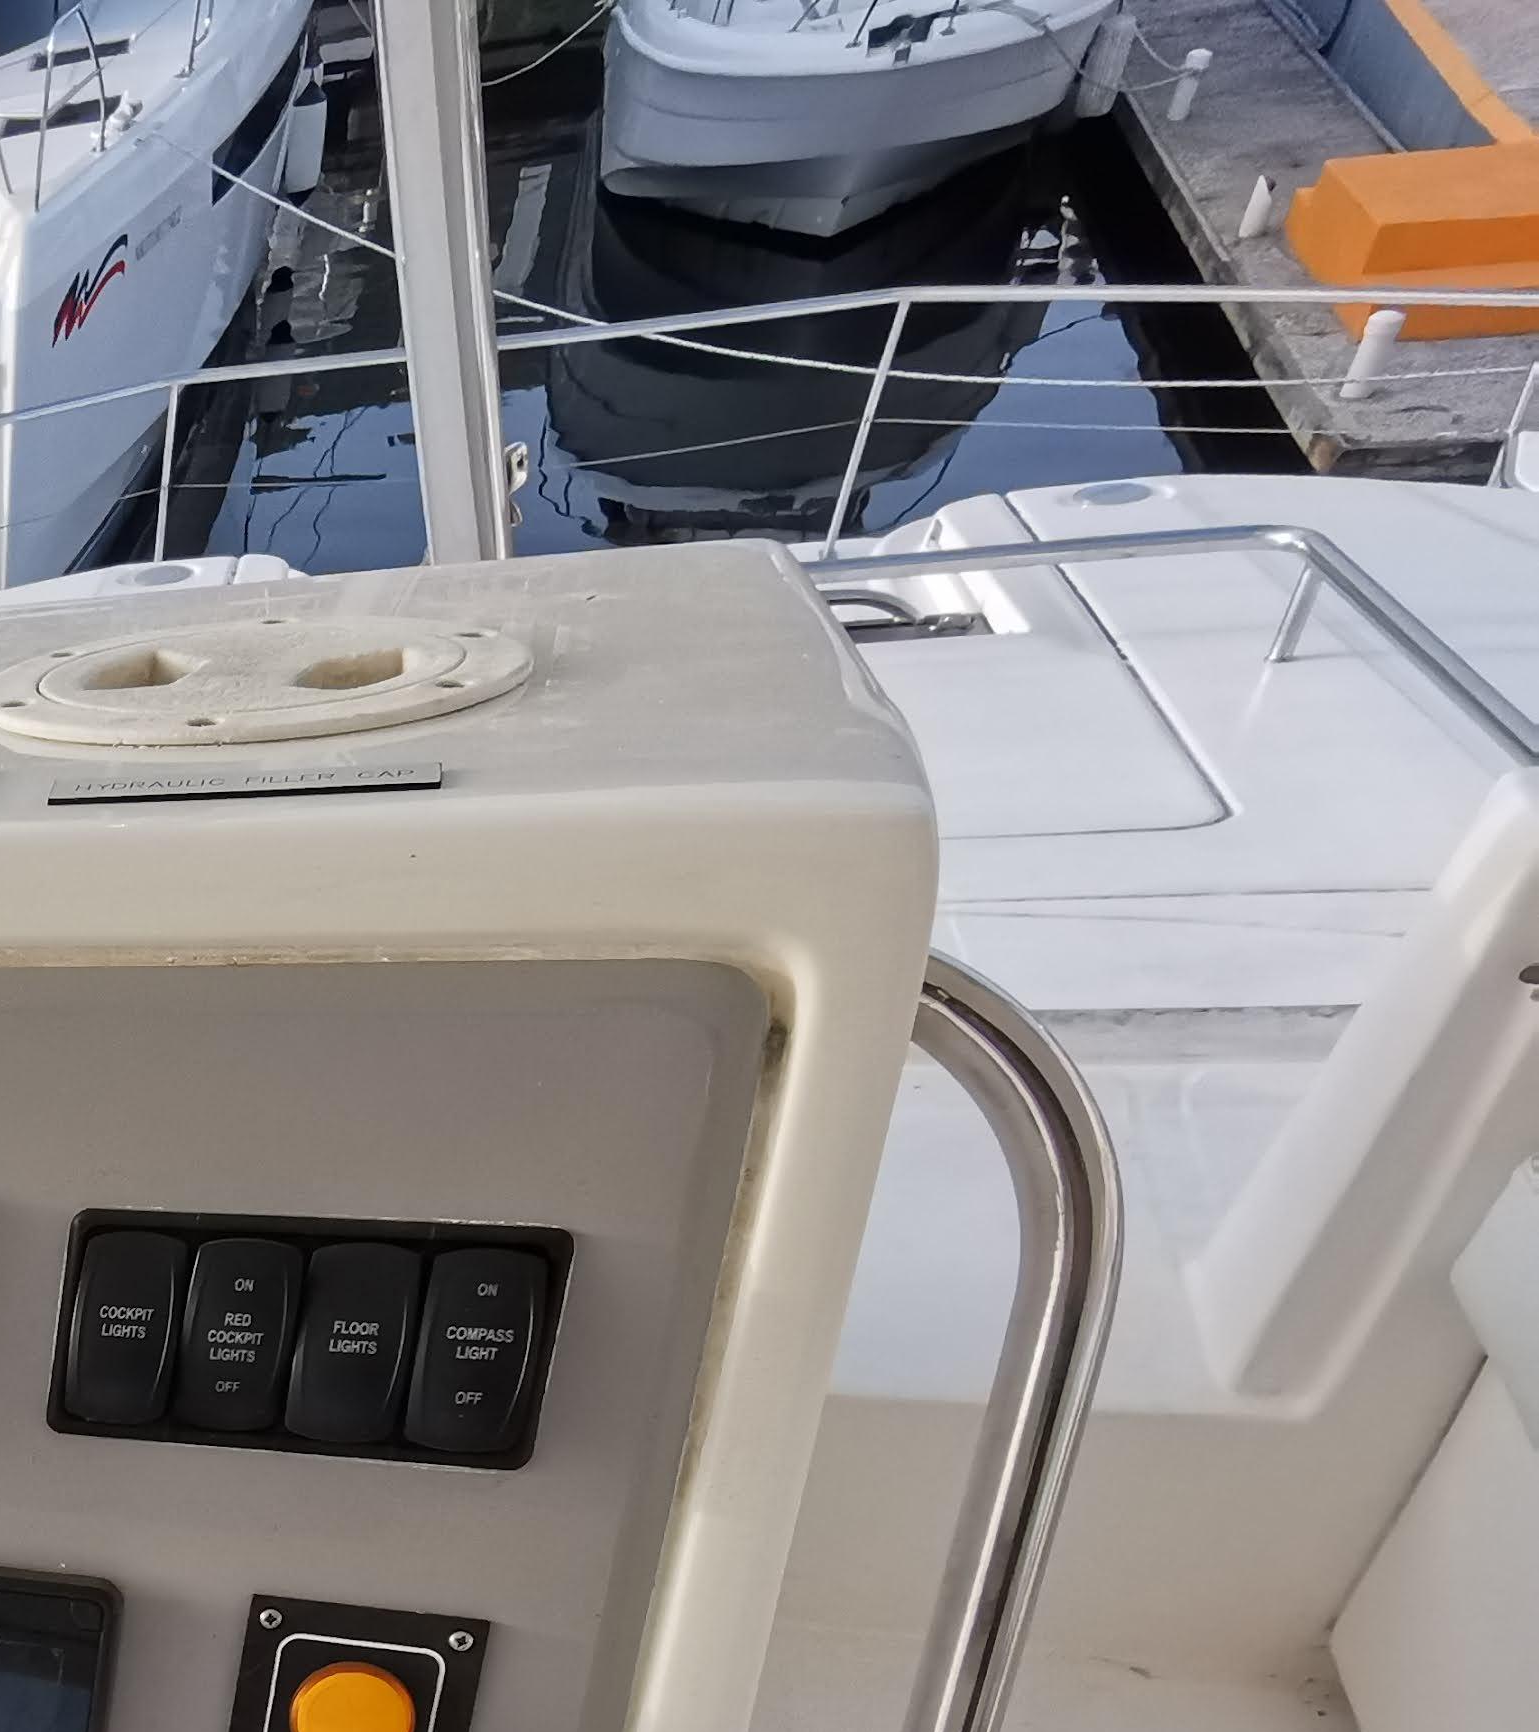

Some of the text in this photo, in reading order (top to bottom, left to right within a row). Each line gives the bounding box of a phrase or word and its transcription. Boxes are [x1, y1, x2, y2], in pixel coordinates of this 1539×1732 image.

[74, 768, 417, 793] HYDRAULIC FILLER CAP
[233, 1277, 255, 1293] ON
[477, 1281, 498, 1298] ON
[99, 1304, 154, 1324] COCKPIT
[224, 1310, 252, 1328] RED
[100, 1321, 147, 1340] LIGHTS
[206, 1328, 264, 1348] COCKPIT
[333, 1318, 379, 1339] FLOOR
[445, 1324, 514, 1345] COMPASS
[208, 1346, 256, 1364] LIGHTS
[328, 1337, 377, 1357] LIGHTS
[455, 1343, 498, 1362] LIGHT
[214, 1378, 241, 1394] OFF
[454, 1390, 483, 1406] OFF
